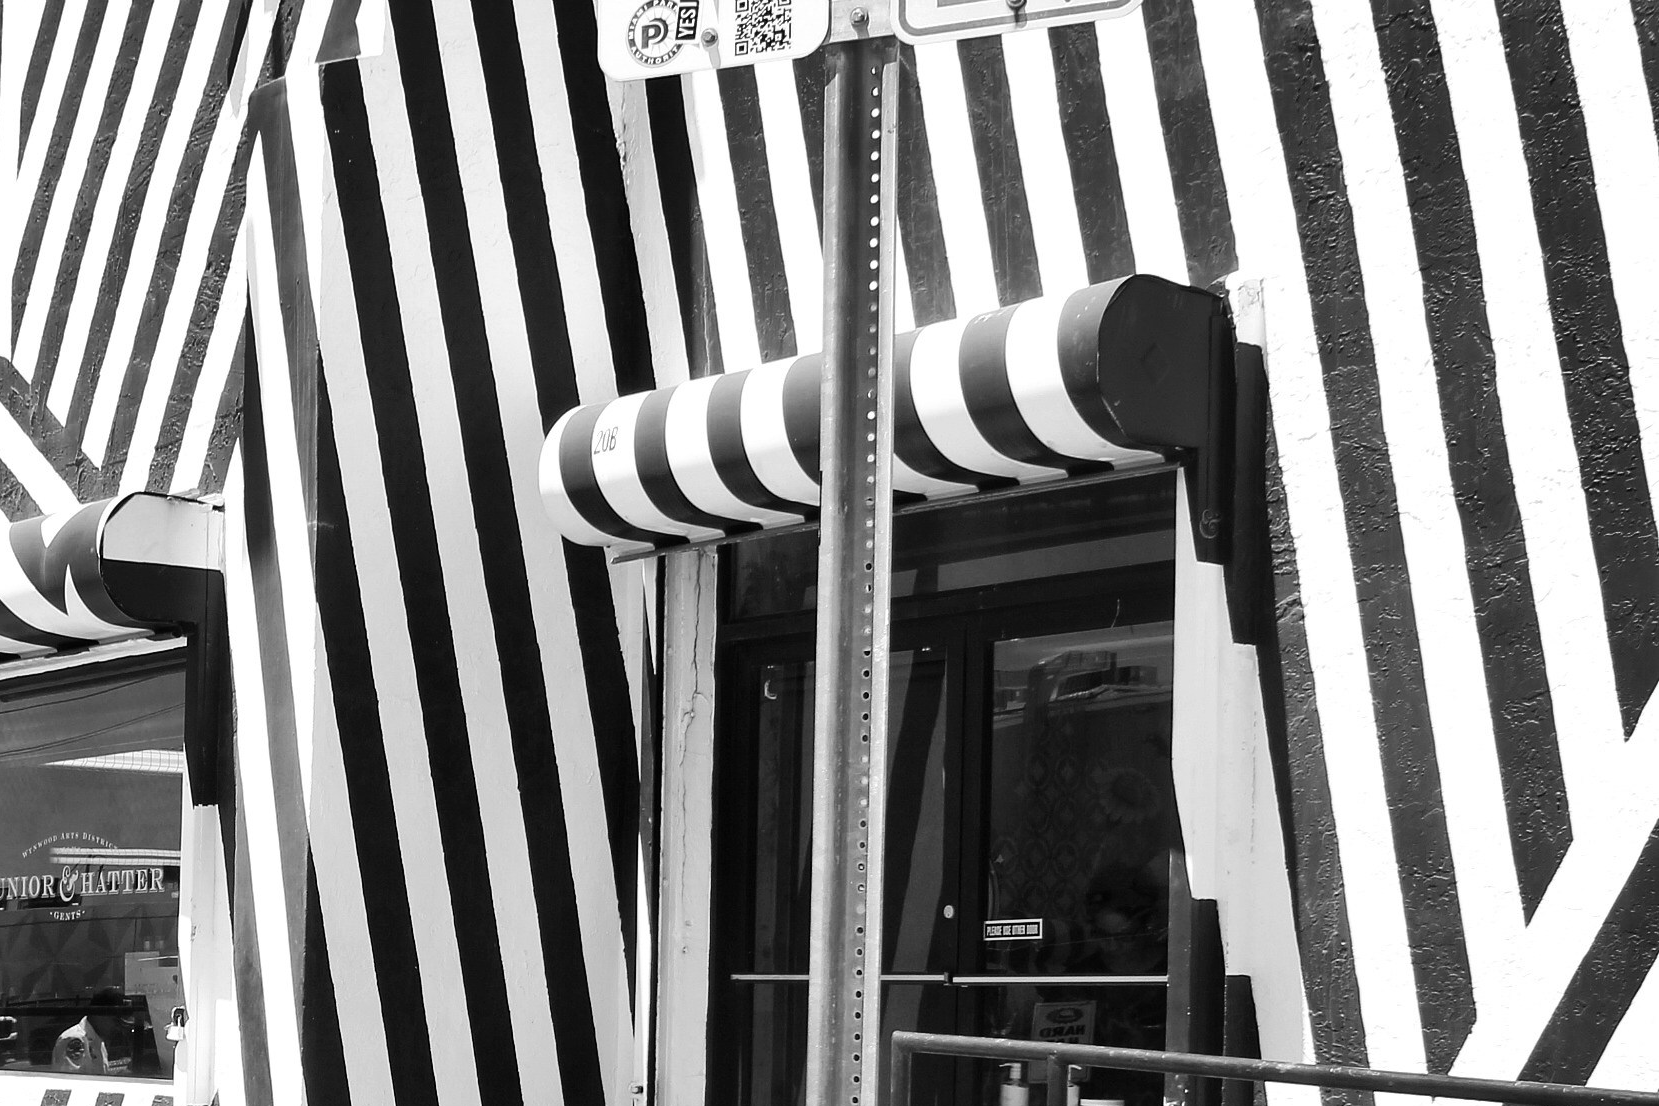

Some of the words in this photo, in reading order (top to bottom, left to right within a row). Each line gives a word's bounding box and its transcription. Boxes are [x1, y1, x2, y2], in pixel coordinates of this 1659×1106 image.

[628, 4, 648, 40] MIAMI
[631, 42, 682, 65] AUTHORIT
[593, 426, 619, 455] 20B
[21, 834, 58, 859] WYNWOOD
[60, 831, 79, 841] ARTS
[59, 865, 79, 902] &
[80, 867, 165, 897] HATTER
